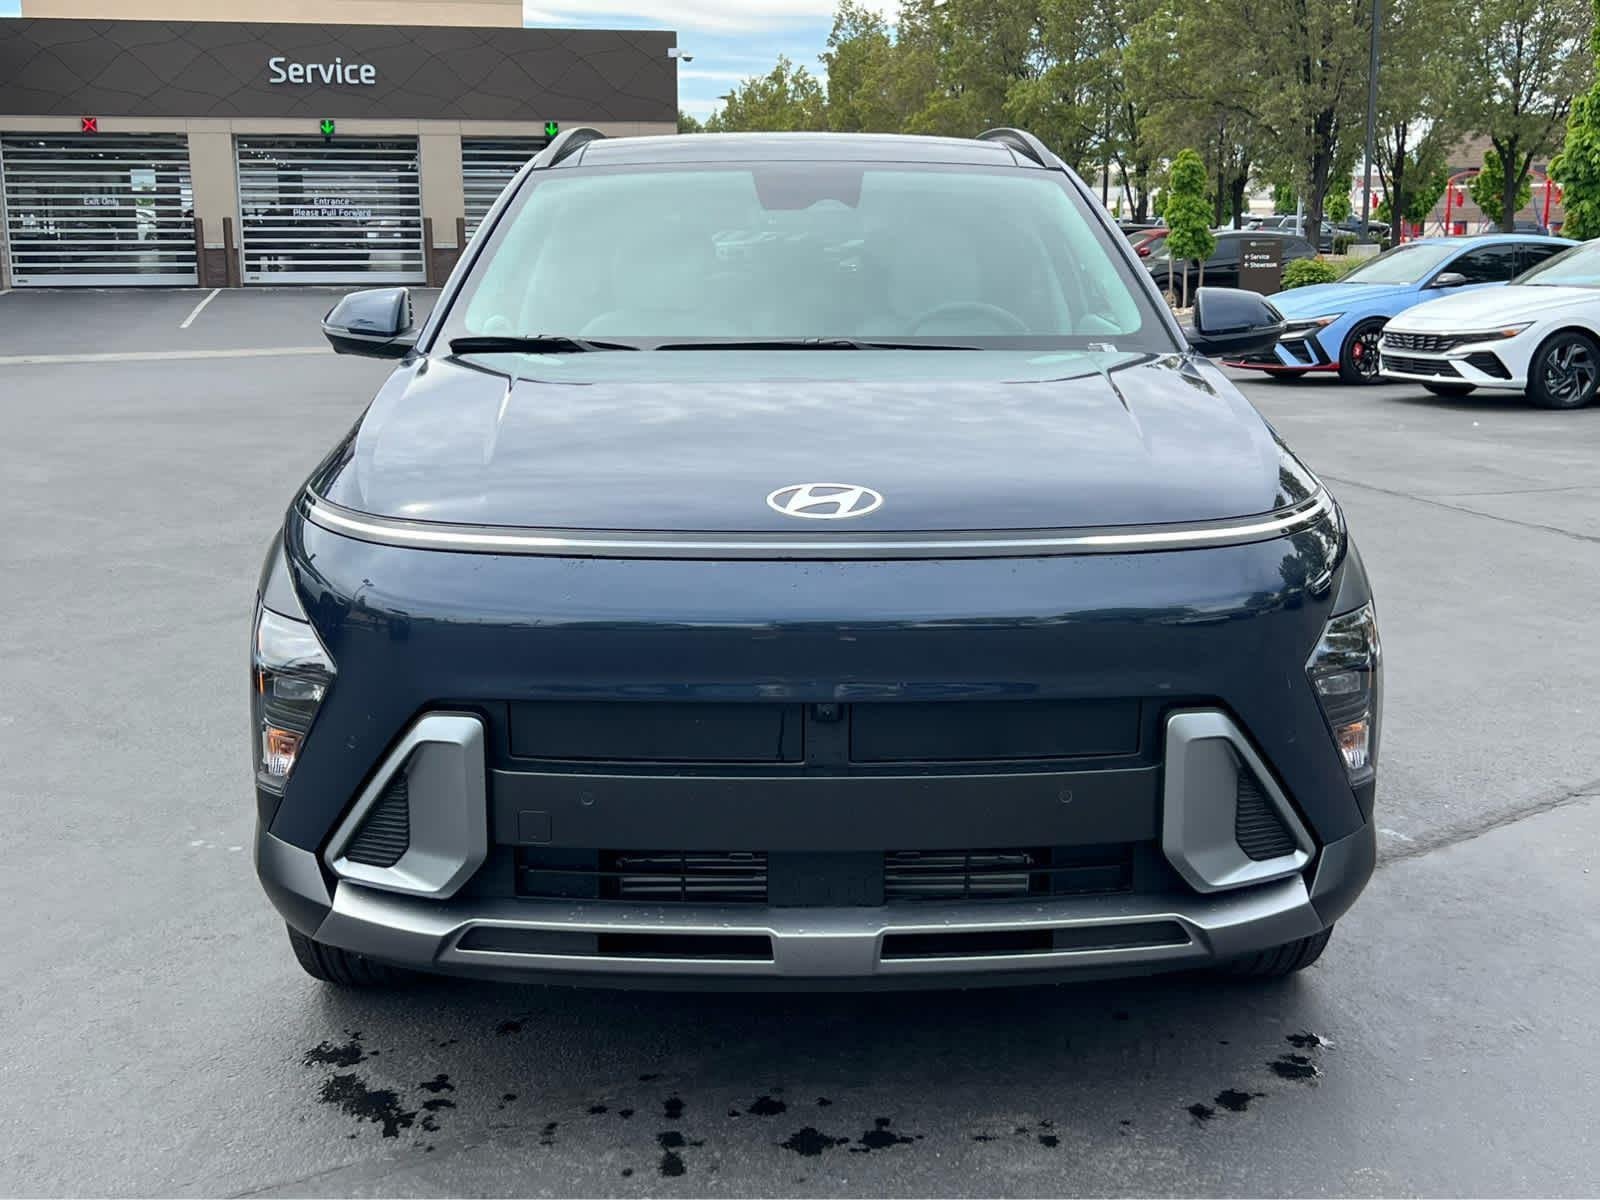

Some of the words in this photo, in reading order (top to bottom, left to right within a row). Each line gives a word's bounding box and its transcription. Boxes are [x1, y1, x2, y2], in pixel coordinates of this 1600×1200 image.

[268, 57, 376, 84] Service
[83, 197, 100, 206] Exit
[102, 197, 119, 208] Only
[313, 197, 350, 206] Entrance
[293, 208, 320, 217] Please
[321, 208, 337, 217] Pull
[339, 208, 372, 217] Forward
